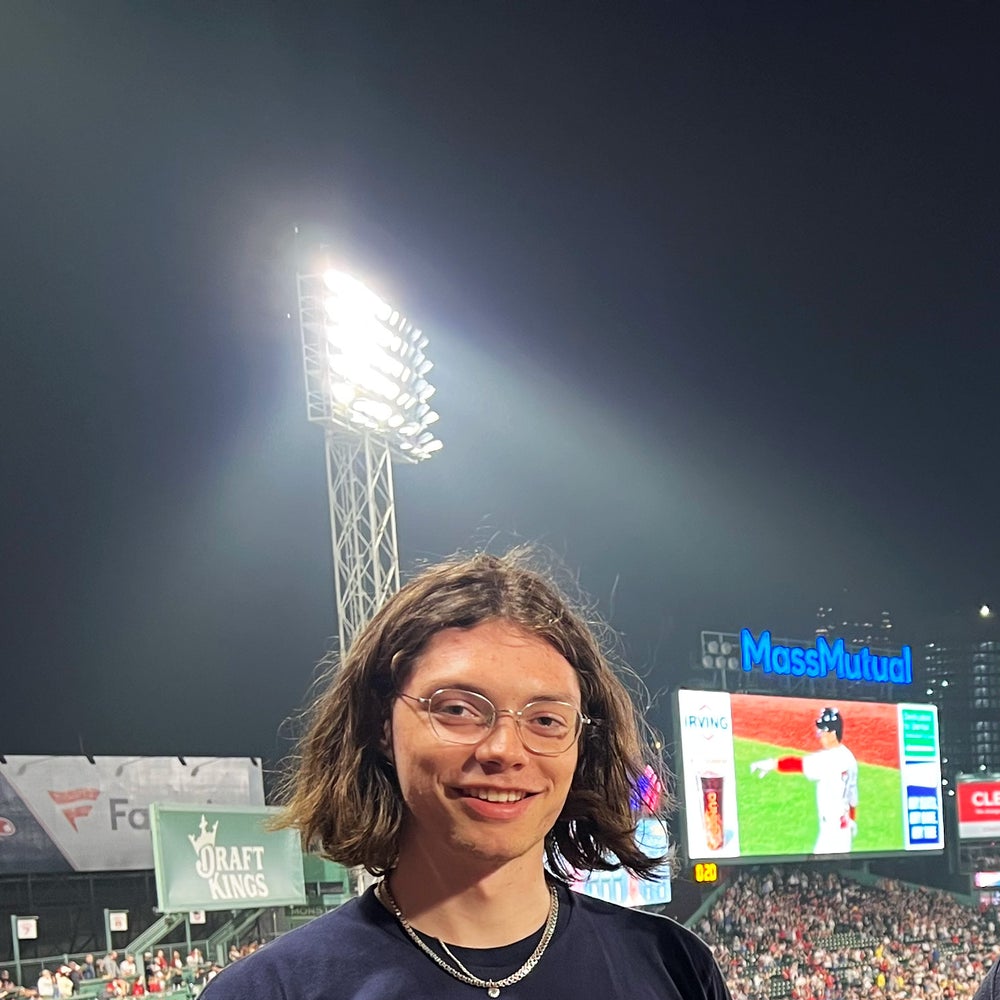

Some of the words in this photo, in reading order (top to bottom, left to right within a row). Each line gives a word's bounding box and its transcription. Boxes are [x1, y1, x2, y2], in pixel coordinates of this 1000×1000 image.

[740, 628, 913, 685] MassMutual
[684, 715, 728, 730] IRVING
[109, 798, 151, 831] Fa
[195, 844, 265, 879] DRAFT
[208, 872, 269, 900] KINGS
